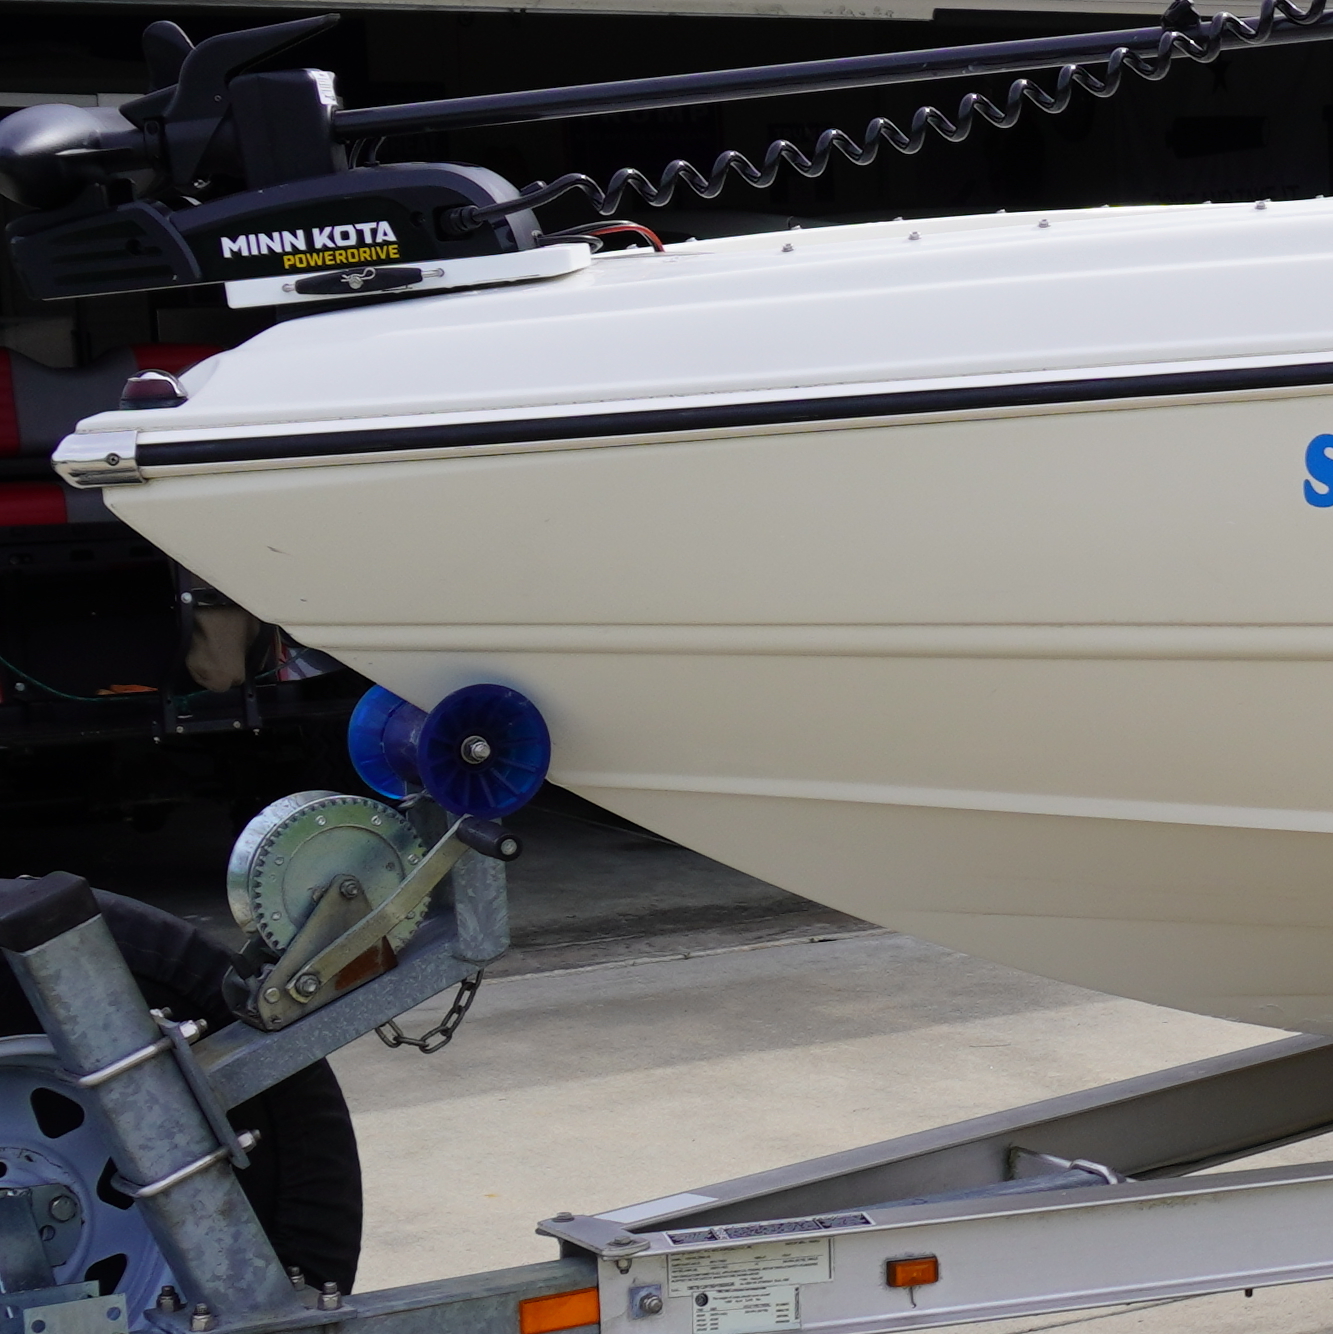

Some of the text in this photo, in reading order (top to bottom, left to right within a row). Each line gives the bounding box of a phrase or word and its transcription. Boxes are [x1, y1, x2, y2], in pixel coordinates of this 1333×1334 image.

[220, 221, 398, 258] MINN KOTA
[283, 244, 400, 269] POWERDRIVE
